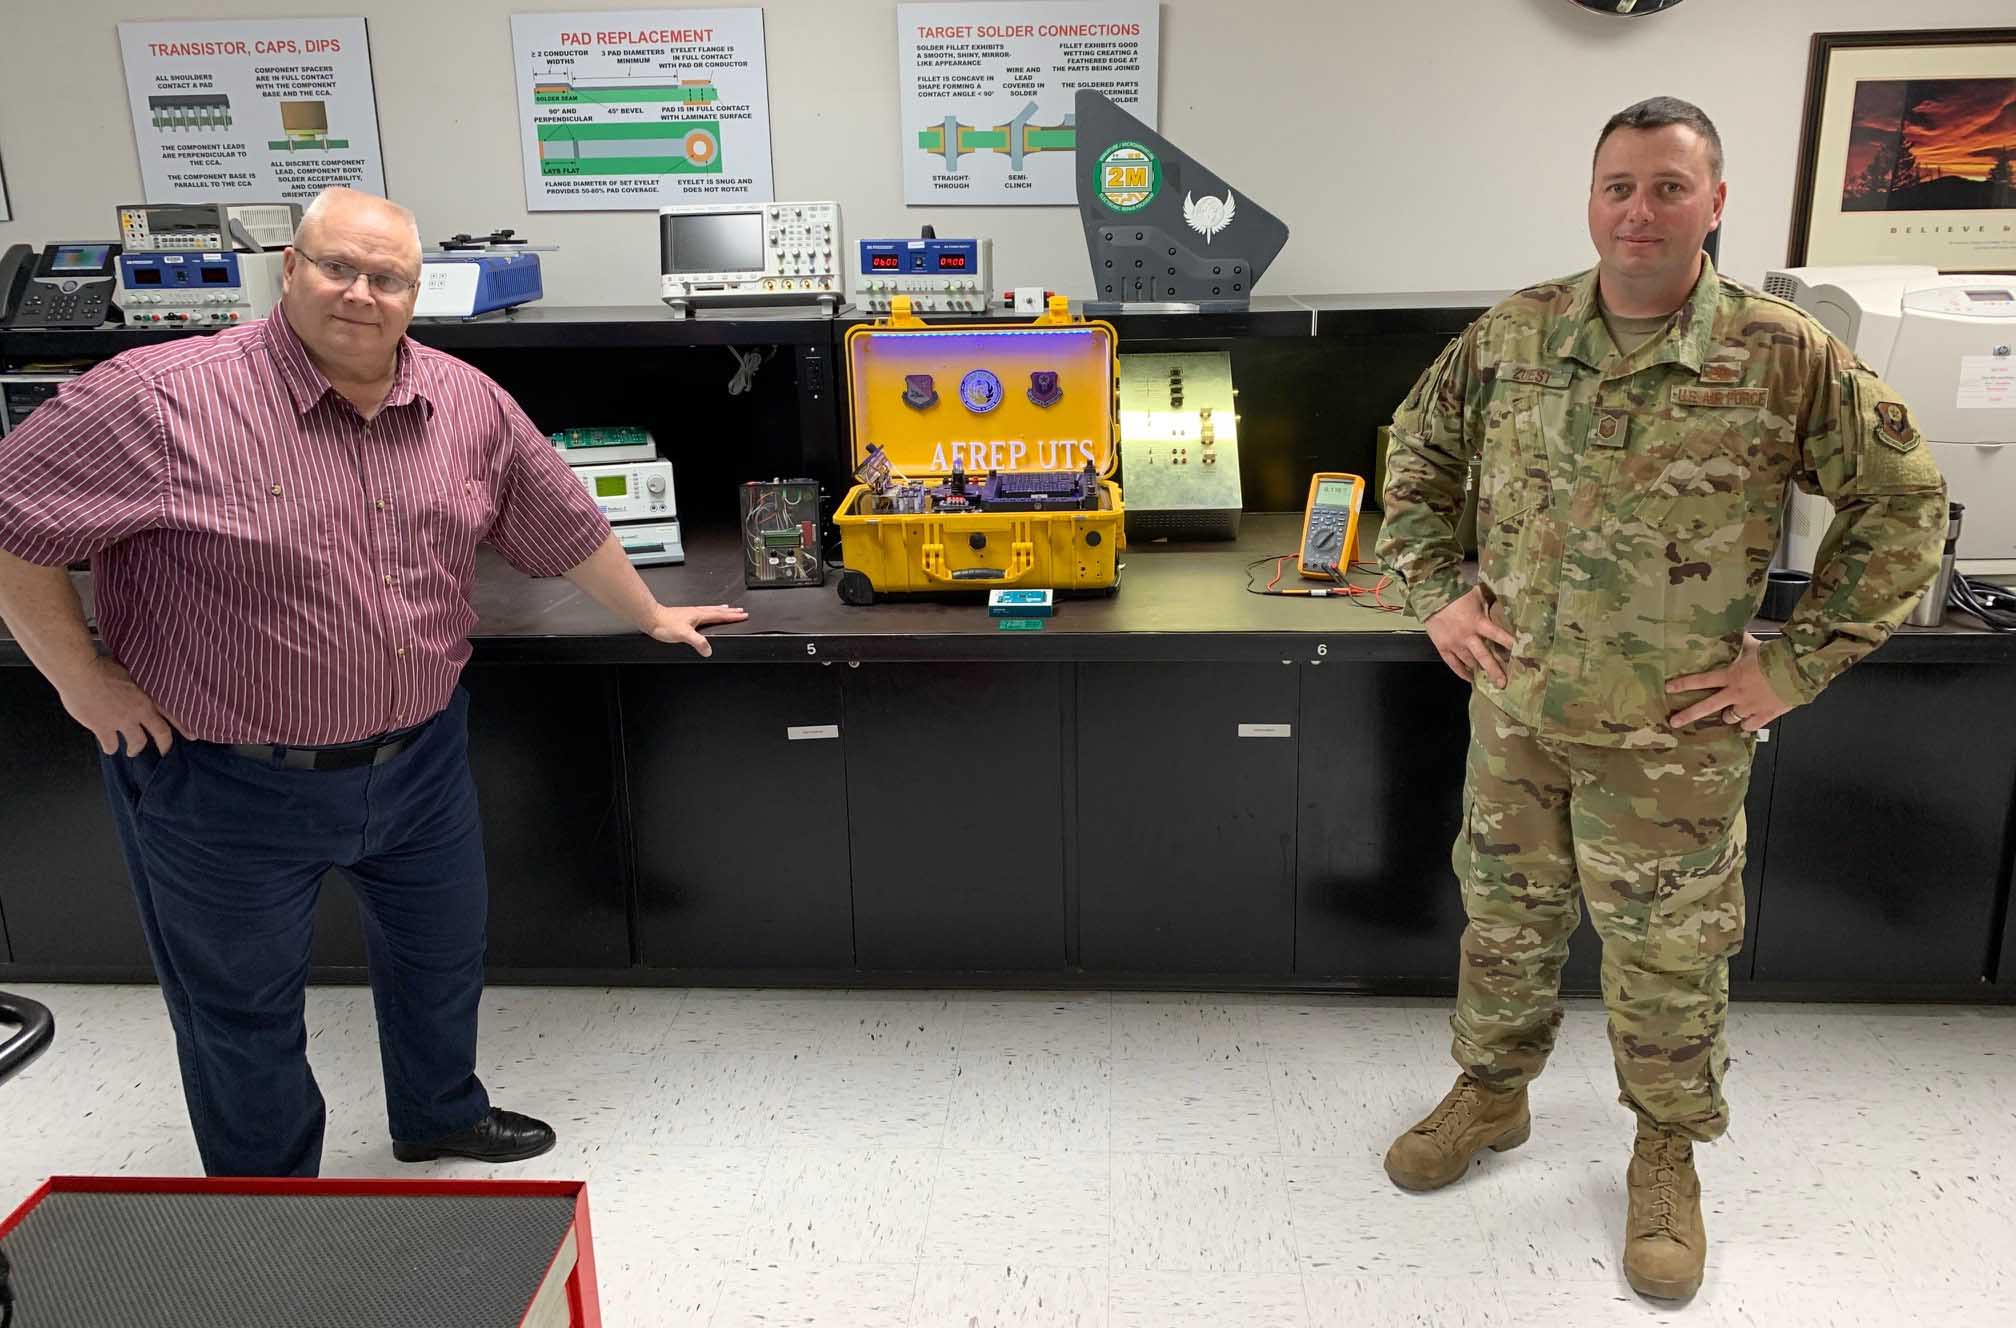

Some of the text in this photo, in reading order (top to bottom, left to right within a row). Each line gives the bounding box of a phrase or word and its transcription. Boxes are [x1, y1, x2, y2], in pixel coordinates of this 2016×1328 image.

[561, 29, 713, 45] PAD REPLACEMENT
[917, 24, 1140, 38] TARGET SOLDER CONNECTIONS
[148, 39, 341, 56] TRANSISTOR, CAPS, DIPS
[301, 65, 333, 73] SPACERS
[1107, 167, 1147, 187] 2M
[929, 439, 1095, 471] AFREP UTS
[807, 643, 816, 655] 5
[1317, 643, 1327, 656] 6
